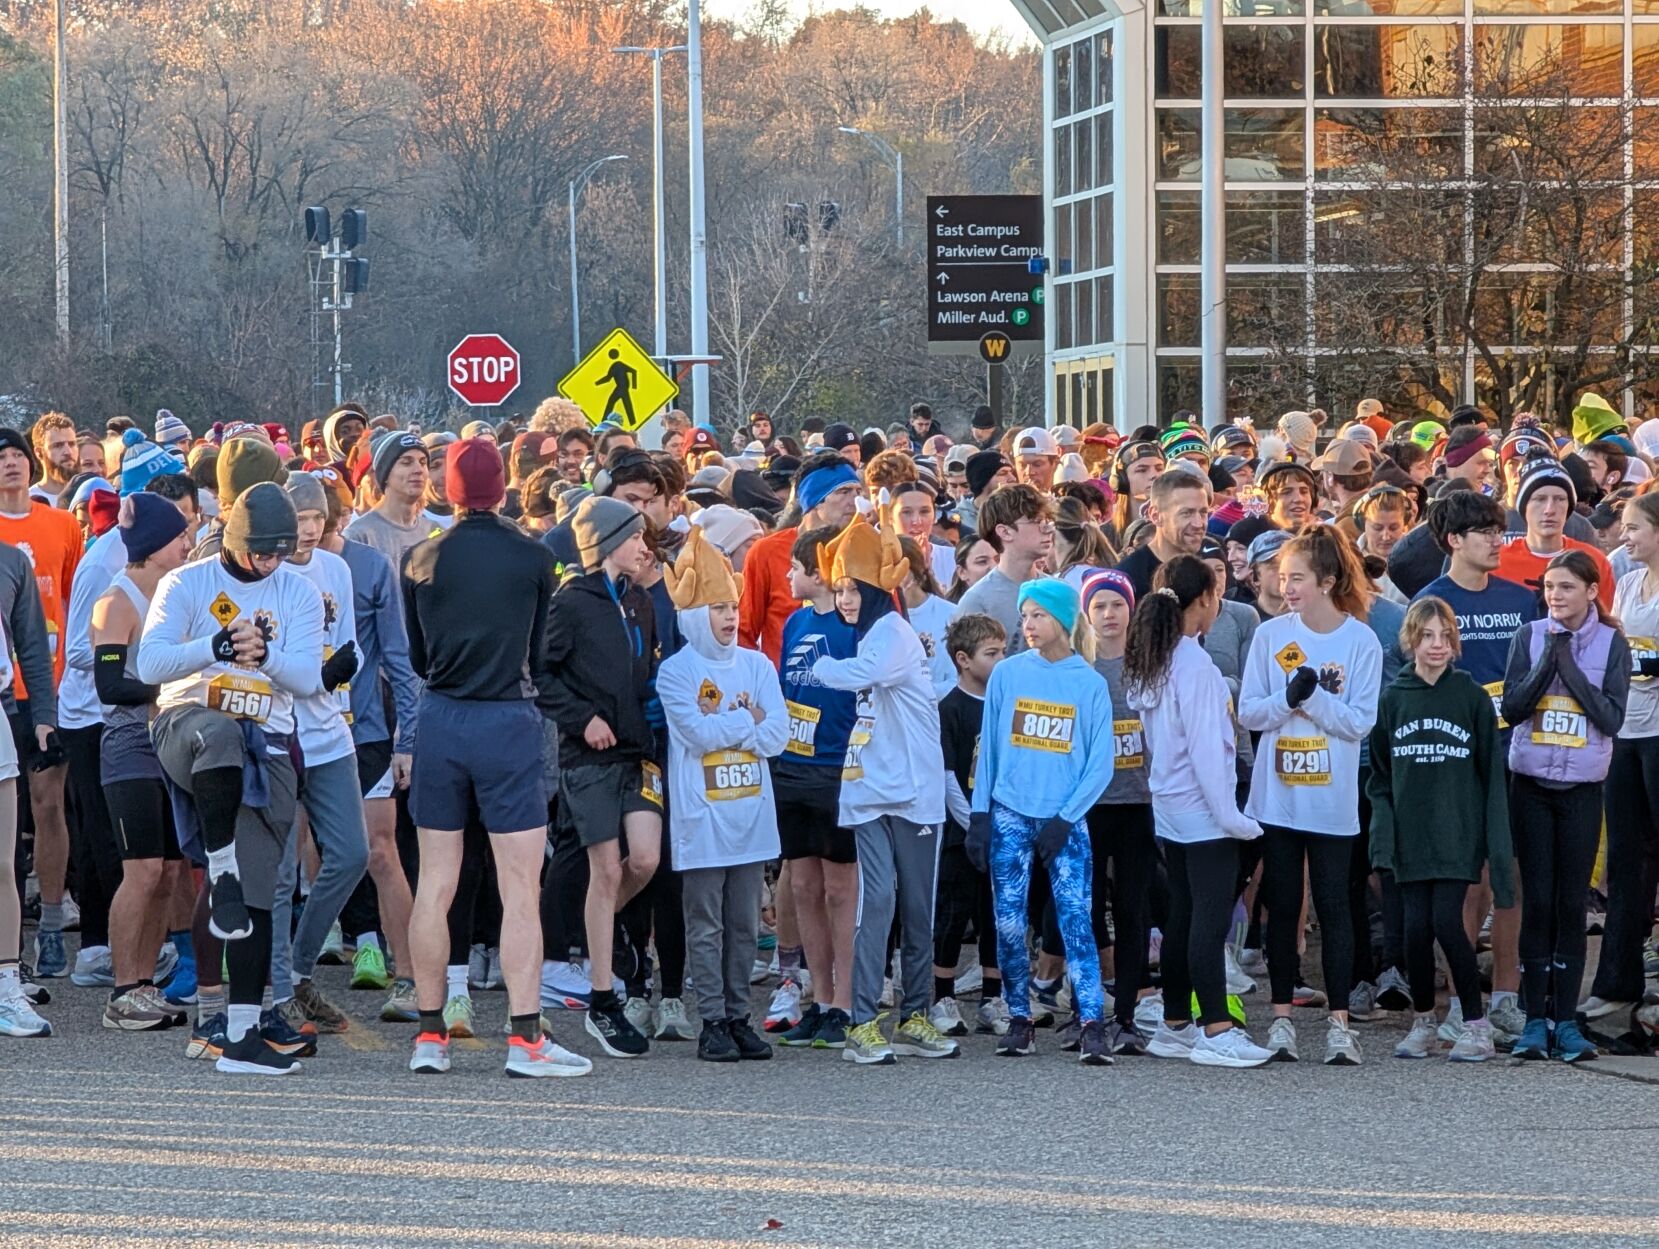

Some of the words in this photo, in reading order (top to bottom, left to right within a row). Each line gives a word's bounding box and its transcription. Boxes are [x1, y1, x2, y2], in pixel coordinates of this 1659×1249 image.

[936, 224, 964, 237] East
[967, 223, 1020, 239] Campus
[936, 244, 997, 257] Parkview
[937, 290, 987, 303] Lawson
[990, 290, 1029, 302] Arena
[937, 310, 976, 324] Miller
[978, 309, 1009, 323] Aud.
[1017, 310, 1027, 322] P
[985, 339, 1006, 357] W
[453, 356, 515, 384] STOP
[1473, 612, 1522, 629] NORRIX
[1478, 632, 1496, 640] CROSS
[1394, 719, 1419, 740] VAN
[1422, 717, 1471, 743] BUREN
[1392, 743, 1435, 757] YOUTH
[1435, 743, 1470, 758] CAMP
